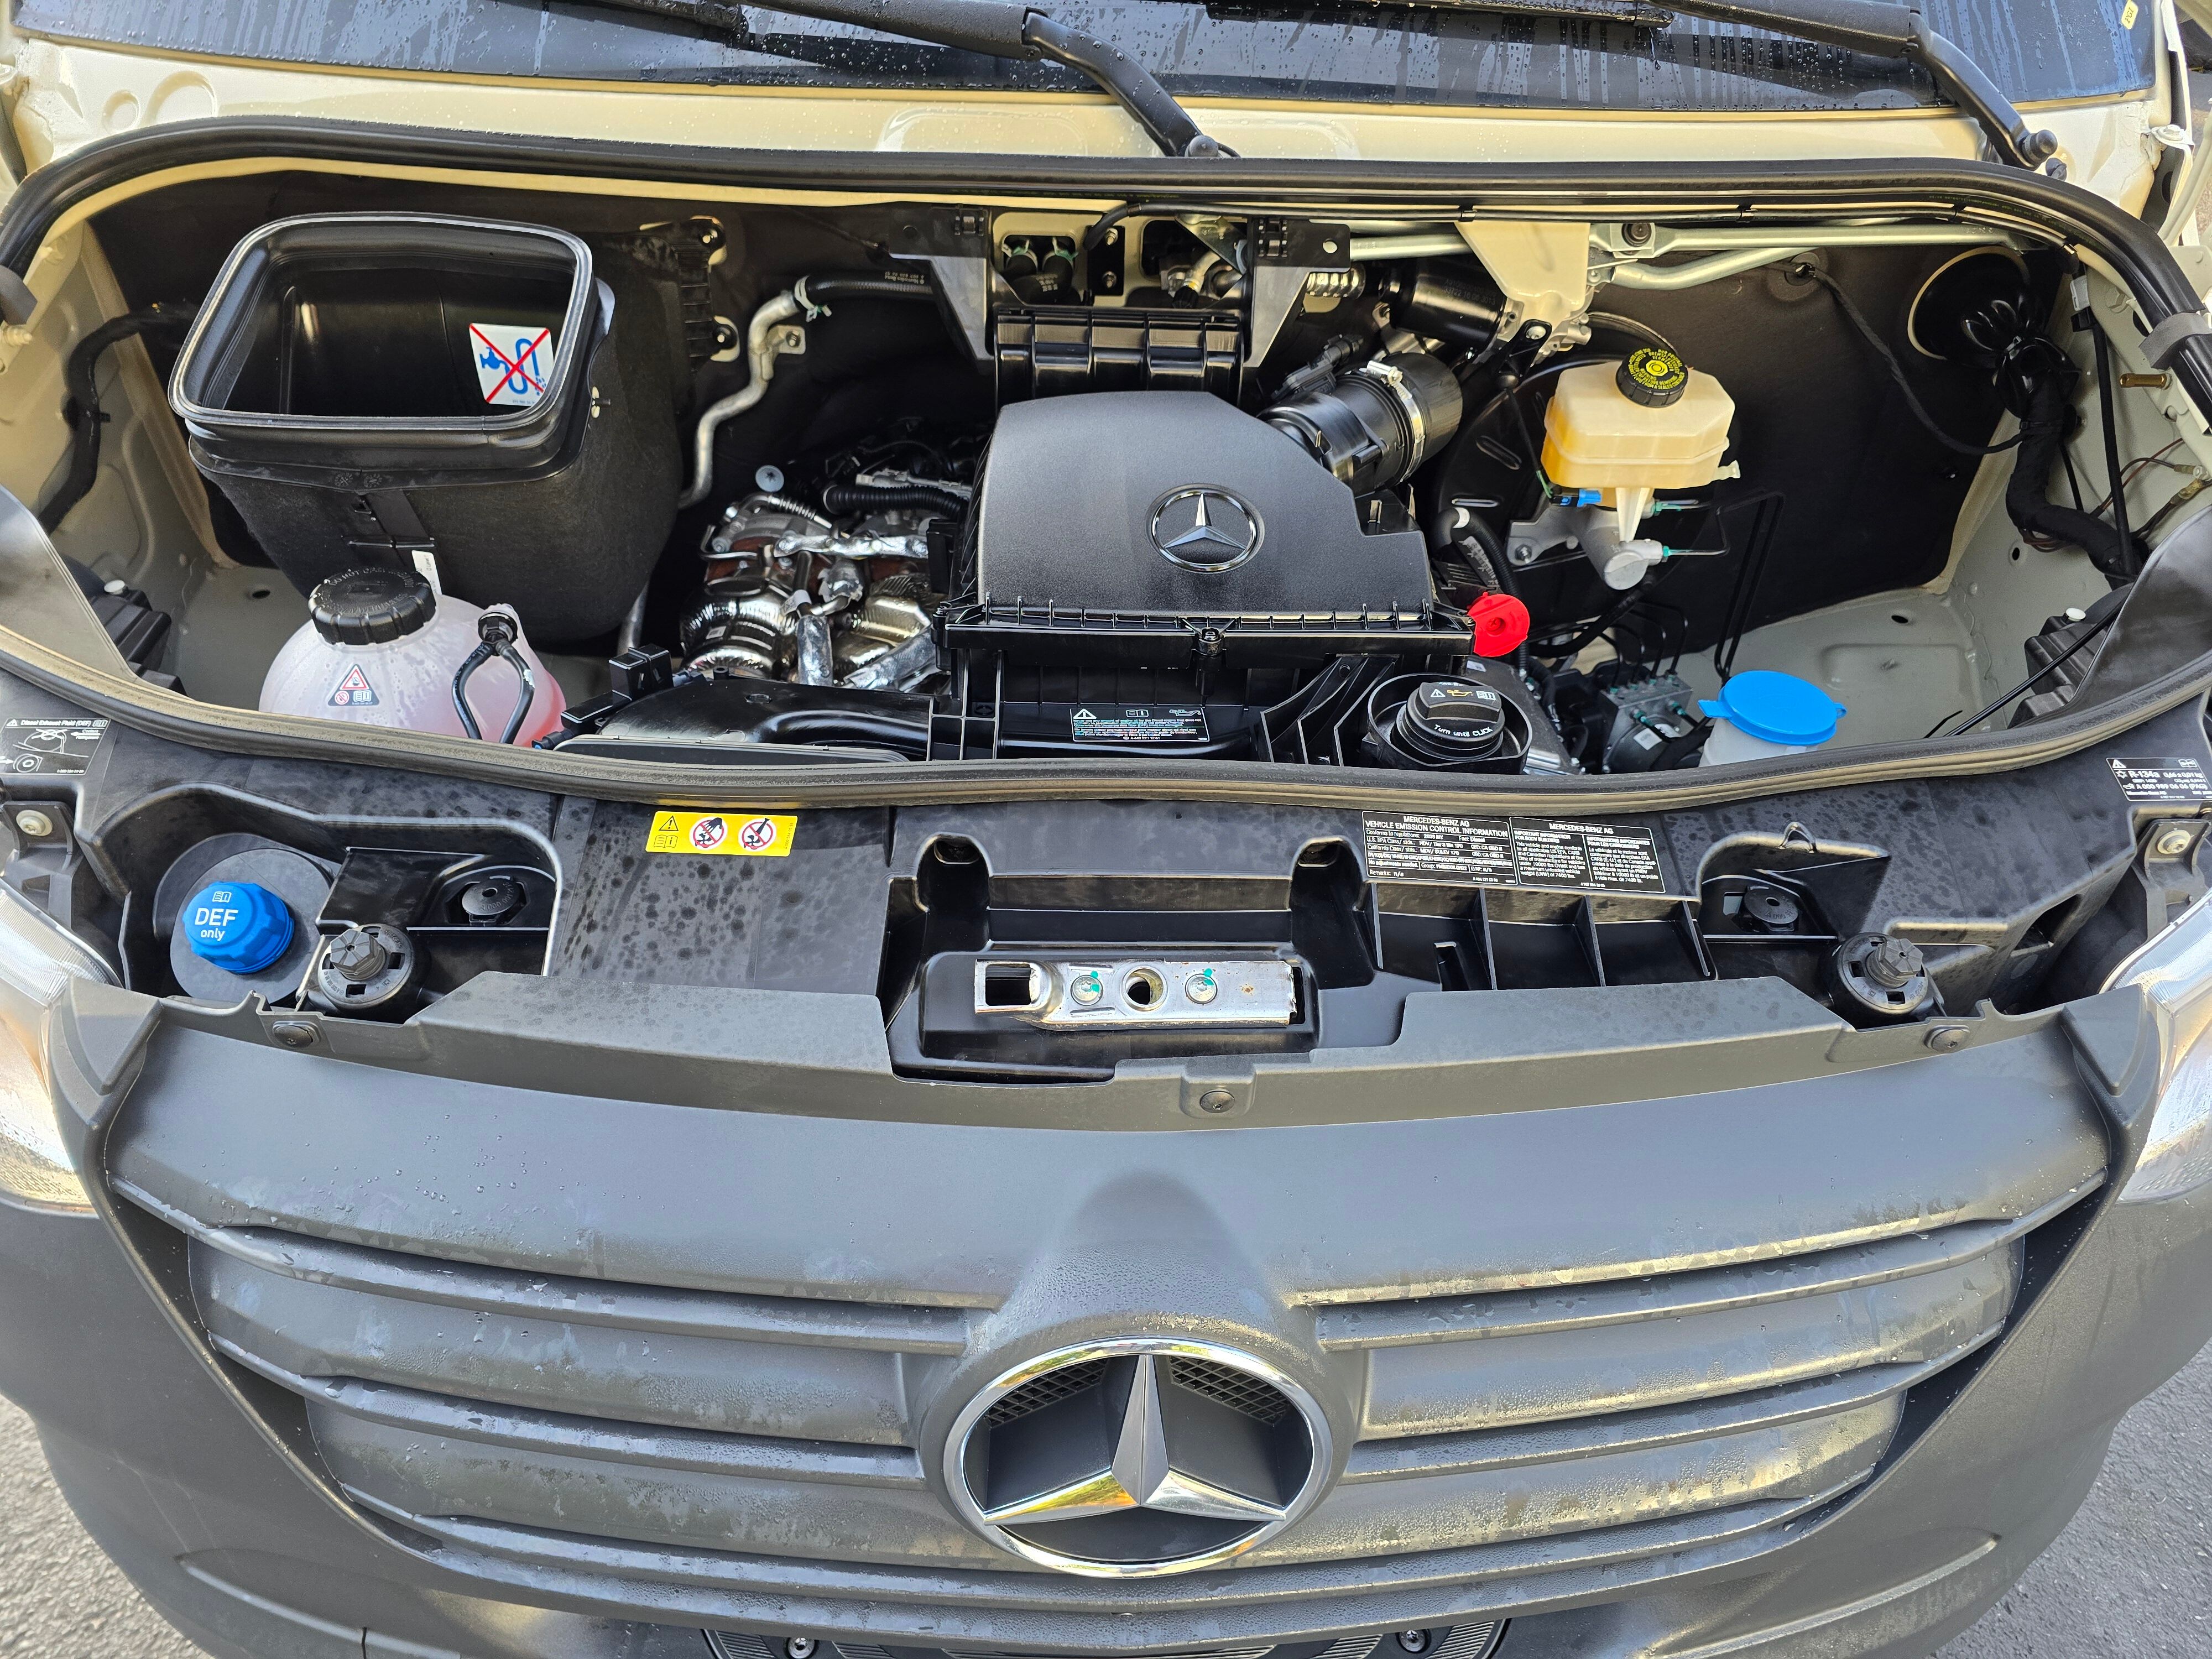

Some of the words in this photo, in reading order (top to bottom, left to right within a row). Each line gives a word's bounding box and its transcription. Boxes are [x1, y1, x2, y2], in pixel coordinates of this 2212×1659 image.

[1434, 724, 1451, 734] Turn
[1472, 727, 1493, 737] CLICK
[1403, 816, 1459, 826] MERCEDES-BENZ
[1395, 822, 1428, 831] EMISSION
[1462, 827, 1508, 837] INFORMATION
[1549, 823, 1603, 833] MERCEDES-BENZ
[195, 907, 238, 926] DEF
[200, 928, 225, 941] only
